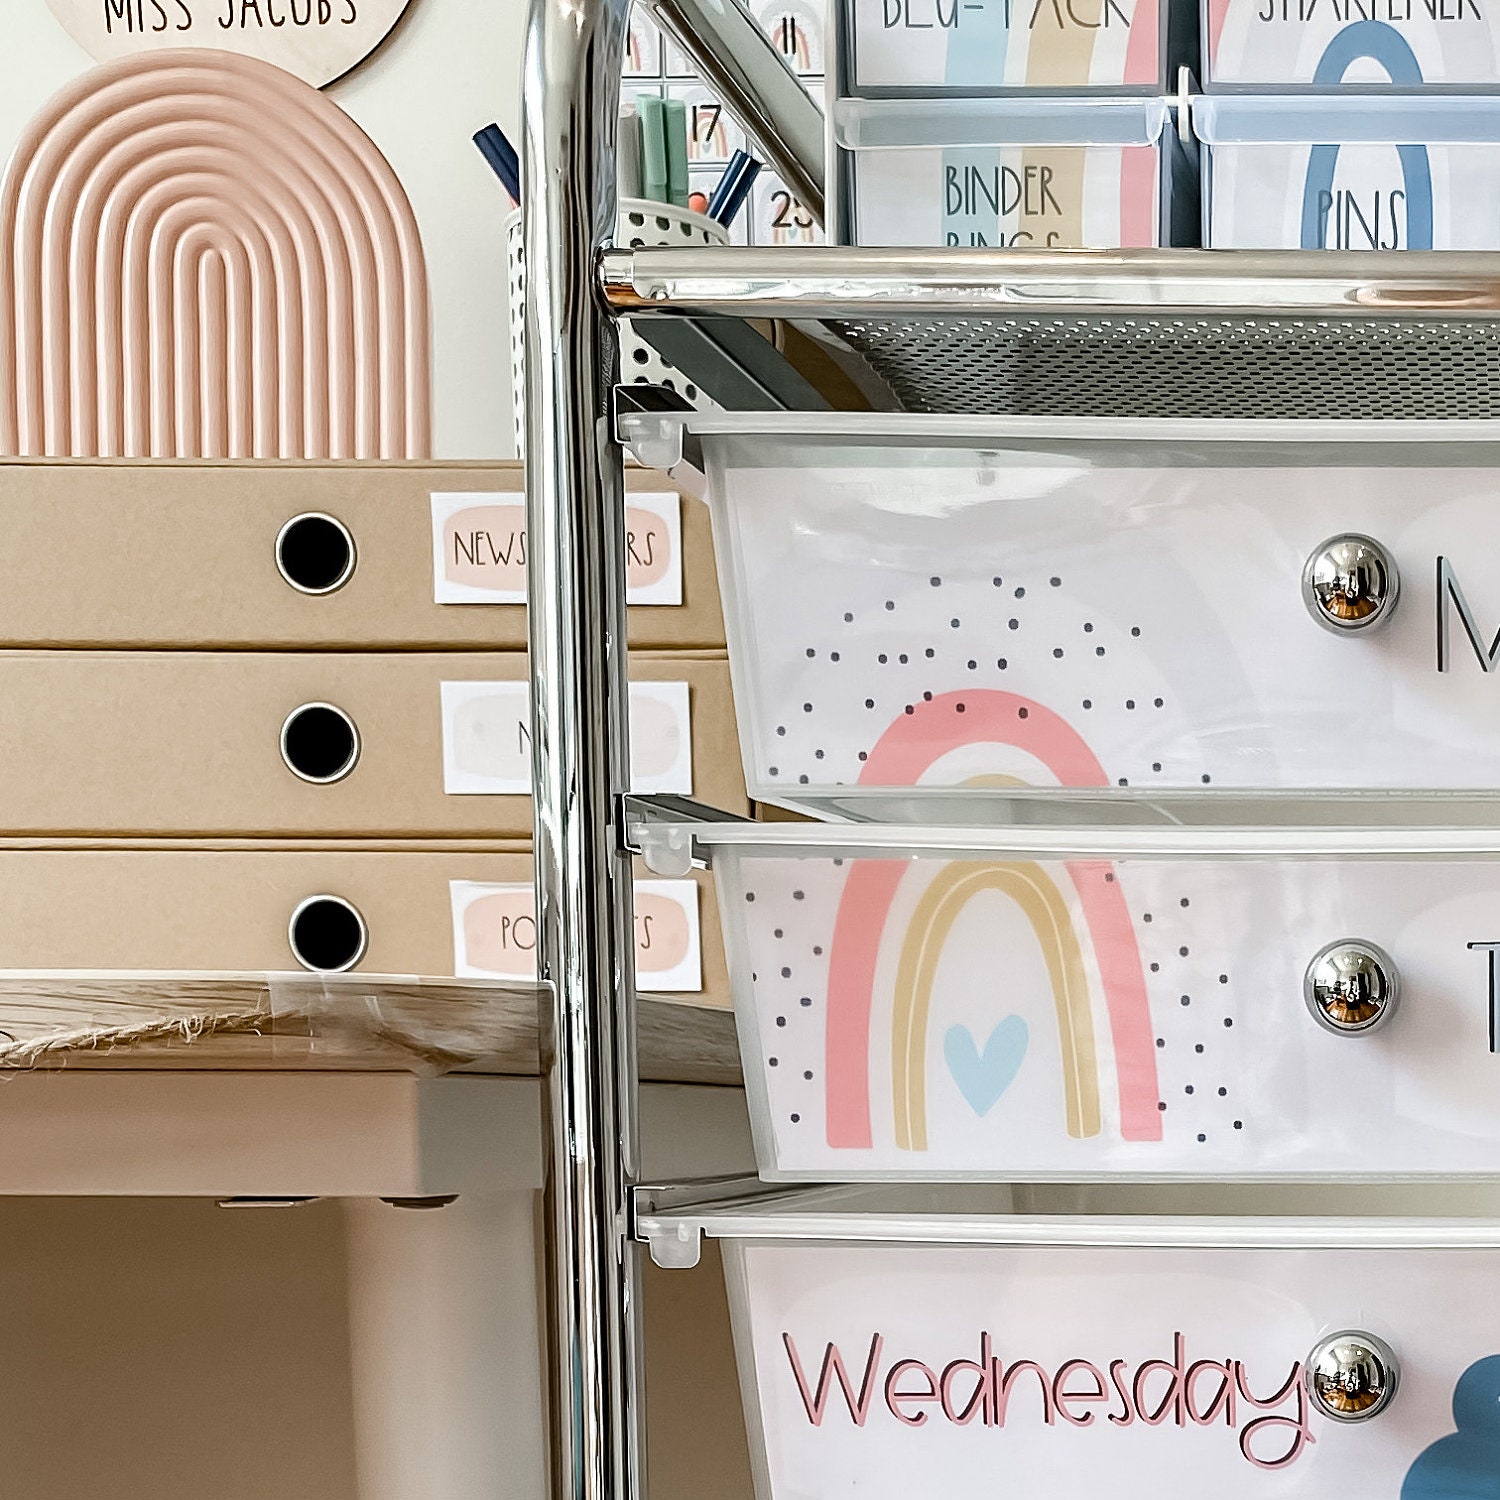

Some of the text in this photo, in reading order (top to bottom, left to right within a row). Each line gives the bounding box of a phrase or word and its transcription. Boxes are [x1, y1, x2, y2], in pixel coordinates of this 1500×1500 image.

[691, 104, 722, 142] 17
[945, 165, 1063, 216] BINDER
[1317, 189, 1405, 250] PINS
[782, 1330, 1316, 1470] Wednesday
